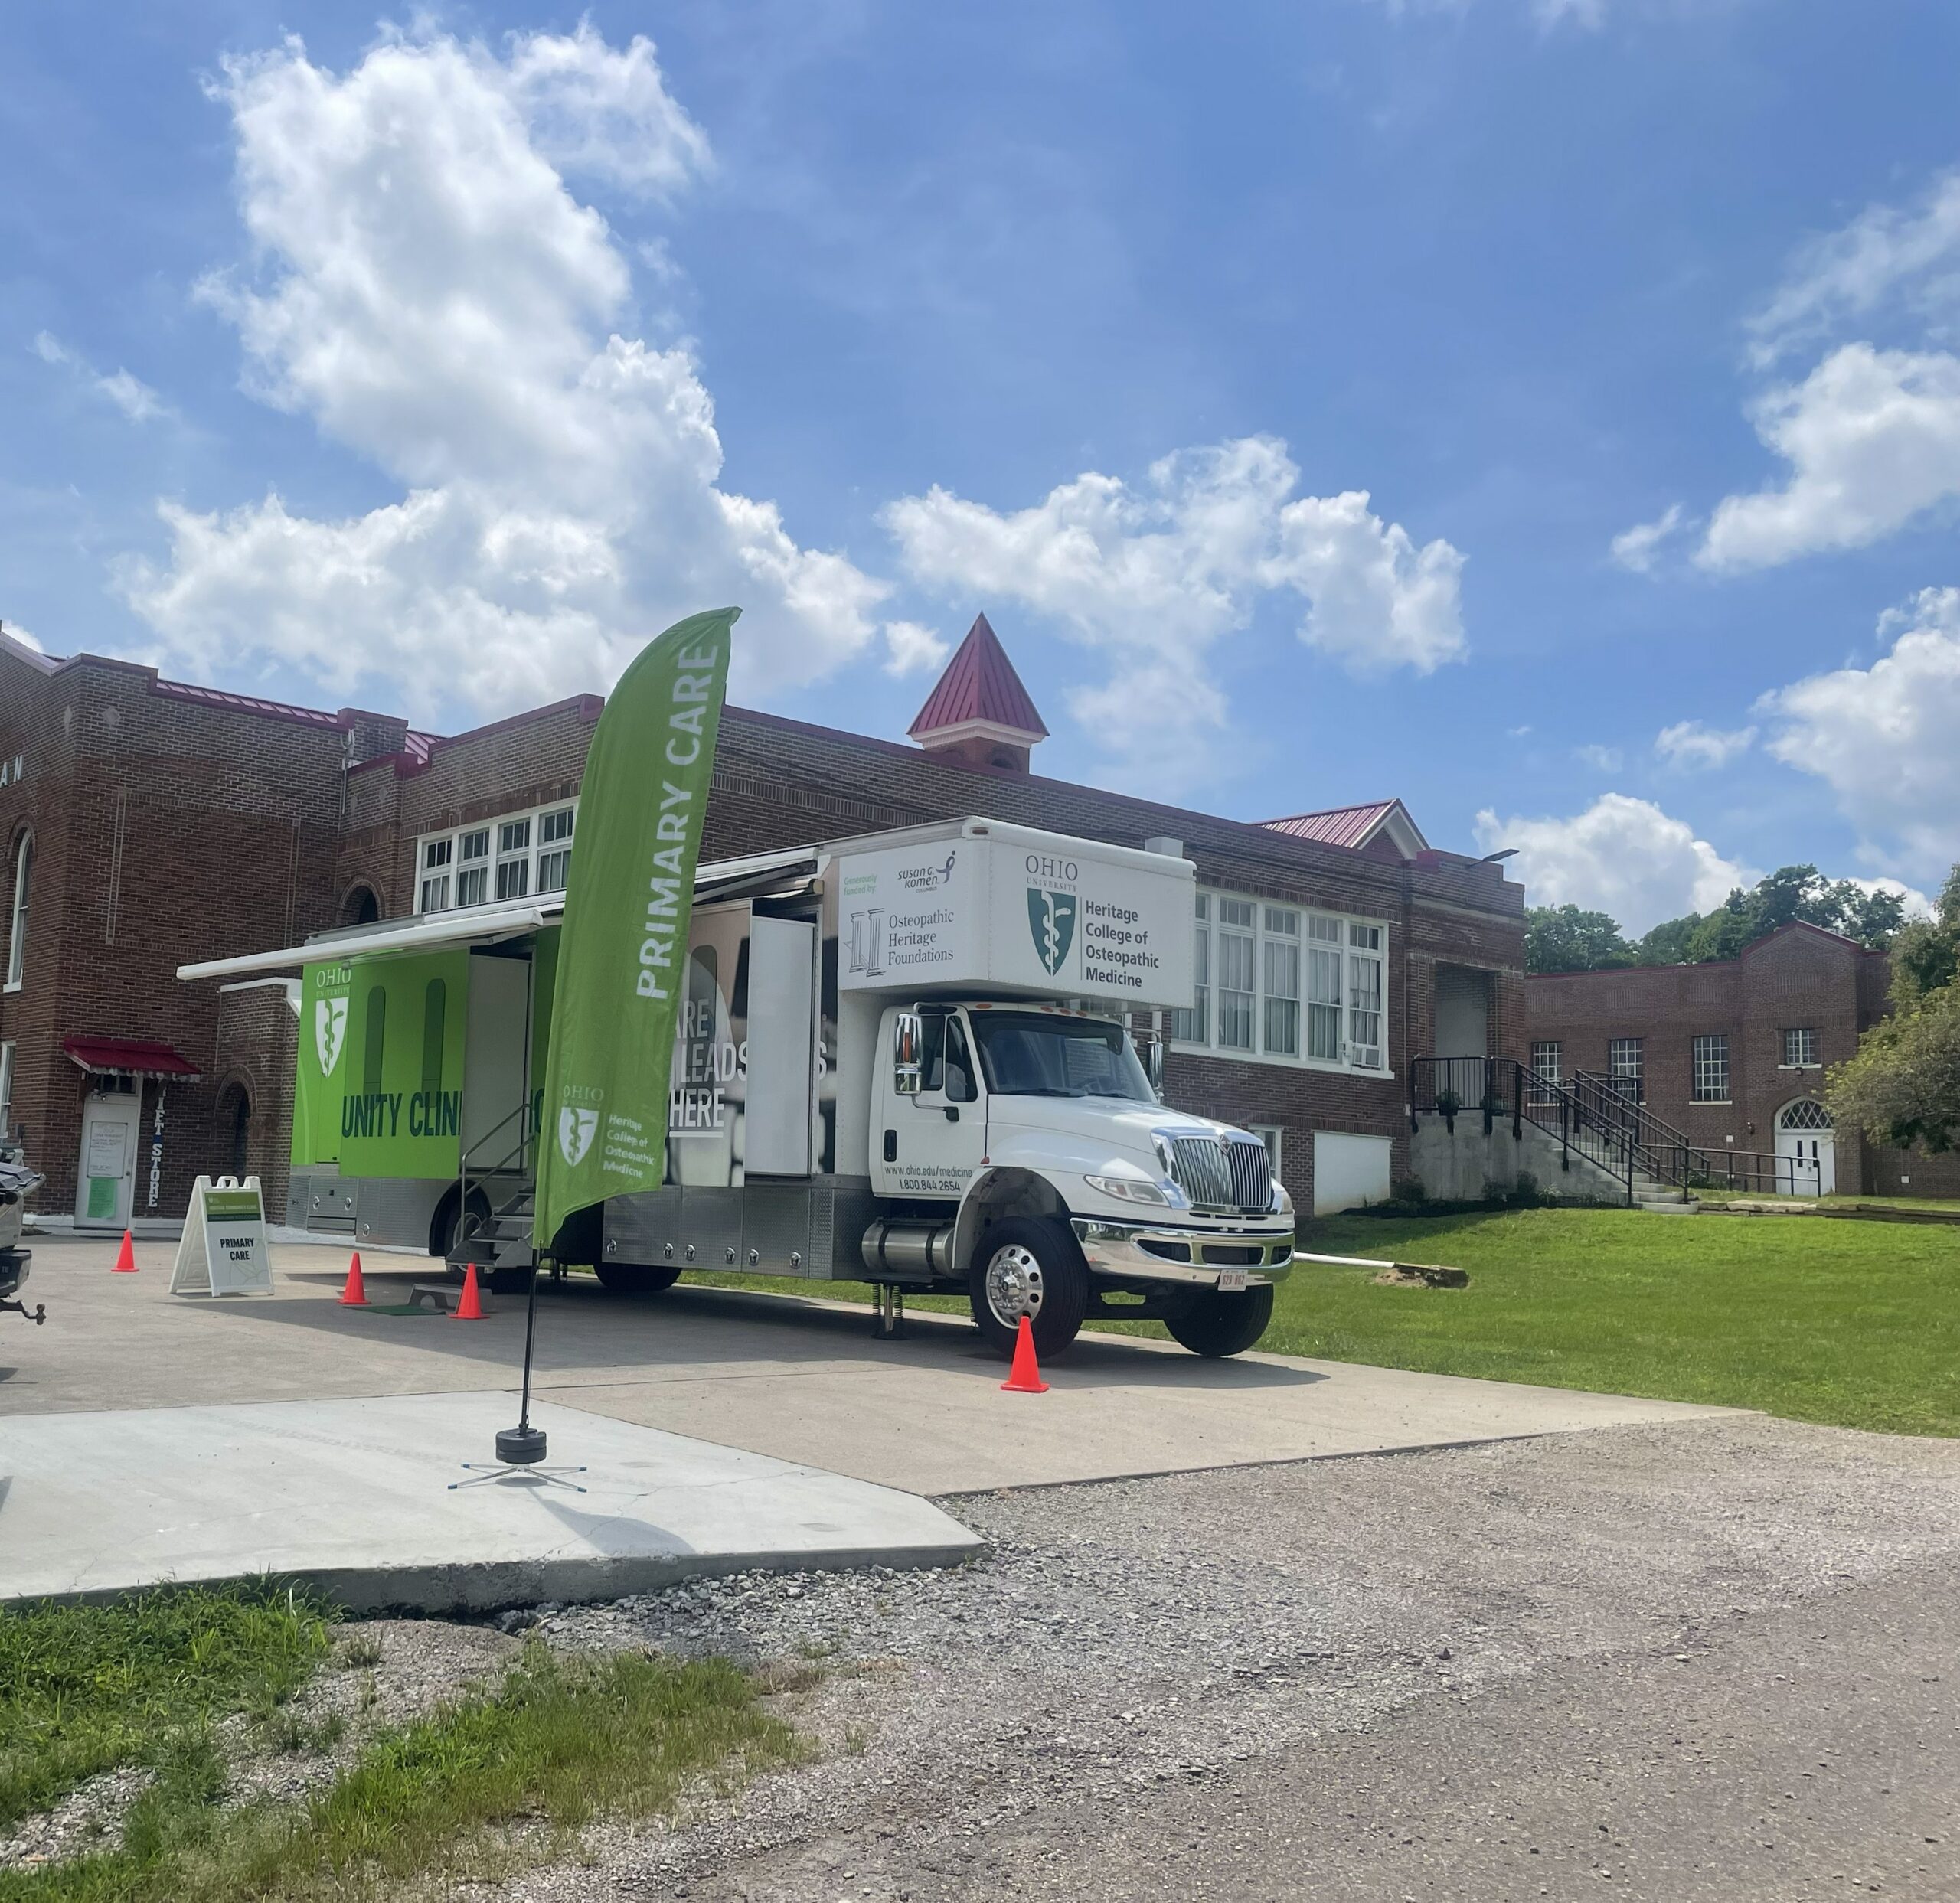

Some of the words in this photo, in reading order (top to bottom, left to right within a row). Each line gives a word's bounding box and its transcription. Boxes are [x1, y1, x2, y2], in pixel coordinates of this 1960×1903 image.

[0, 755, 23, 788] AN
[636, 780, 692, 999] PRIMARY
[666, 645, 718, 765] CARE
[1026, 855, 1078, 881] OHIO
[844, 874, 877, 885] Generously
[1027, 877, 1077, 893] UNIVERSITY
[844, 885, 865, 896] funded
[889, 909, 954, 929] Osteopathic
[1086, 900, 1138, 924] Heritage
[888, 932, 936, 948] Heritage
[1086, 922, 1132, 945] College
[1135, 931, 1148, 945] of
[888, 948, 954, 965] Foundations
[1086, 945, 1159, 968] Osteopathic
[317, 968, 351, 987] OHIO
[1086, 967, 1142, 987] Medicine
[563, 1085, 604, 1102] OHIO
[341, 1092, 403, 1138] UNITY
[669, 1088, 726, 1127] HERE
[639, 1138, 648, 1147] of
[148, 1143, 163, 1208] STORE
[884, 1164, 972, 1177] www.ohio.edu/medicine
[899, 1179, 961, 1191] 1.800.844.2654
[220, 1237, 254, 1249] PRIMARY
[230, 1250, 250, 1261] CARE
